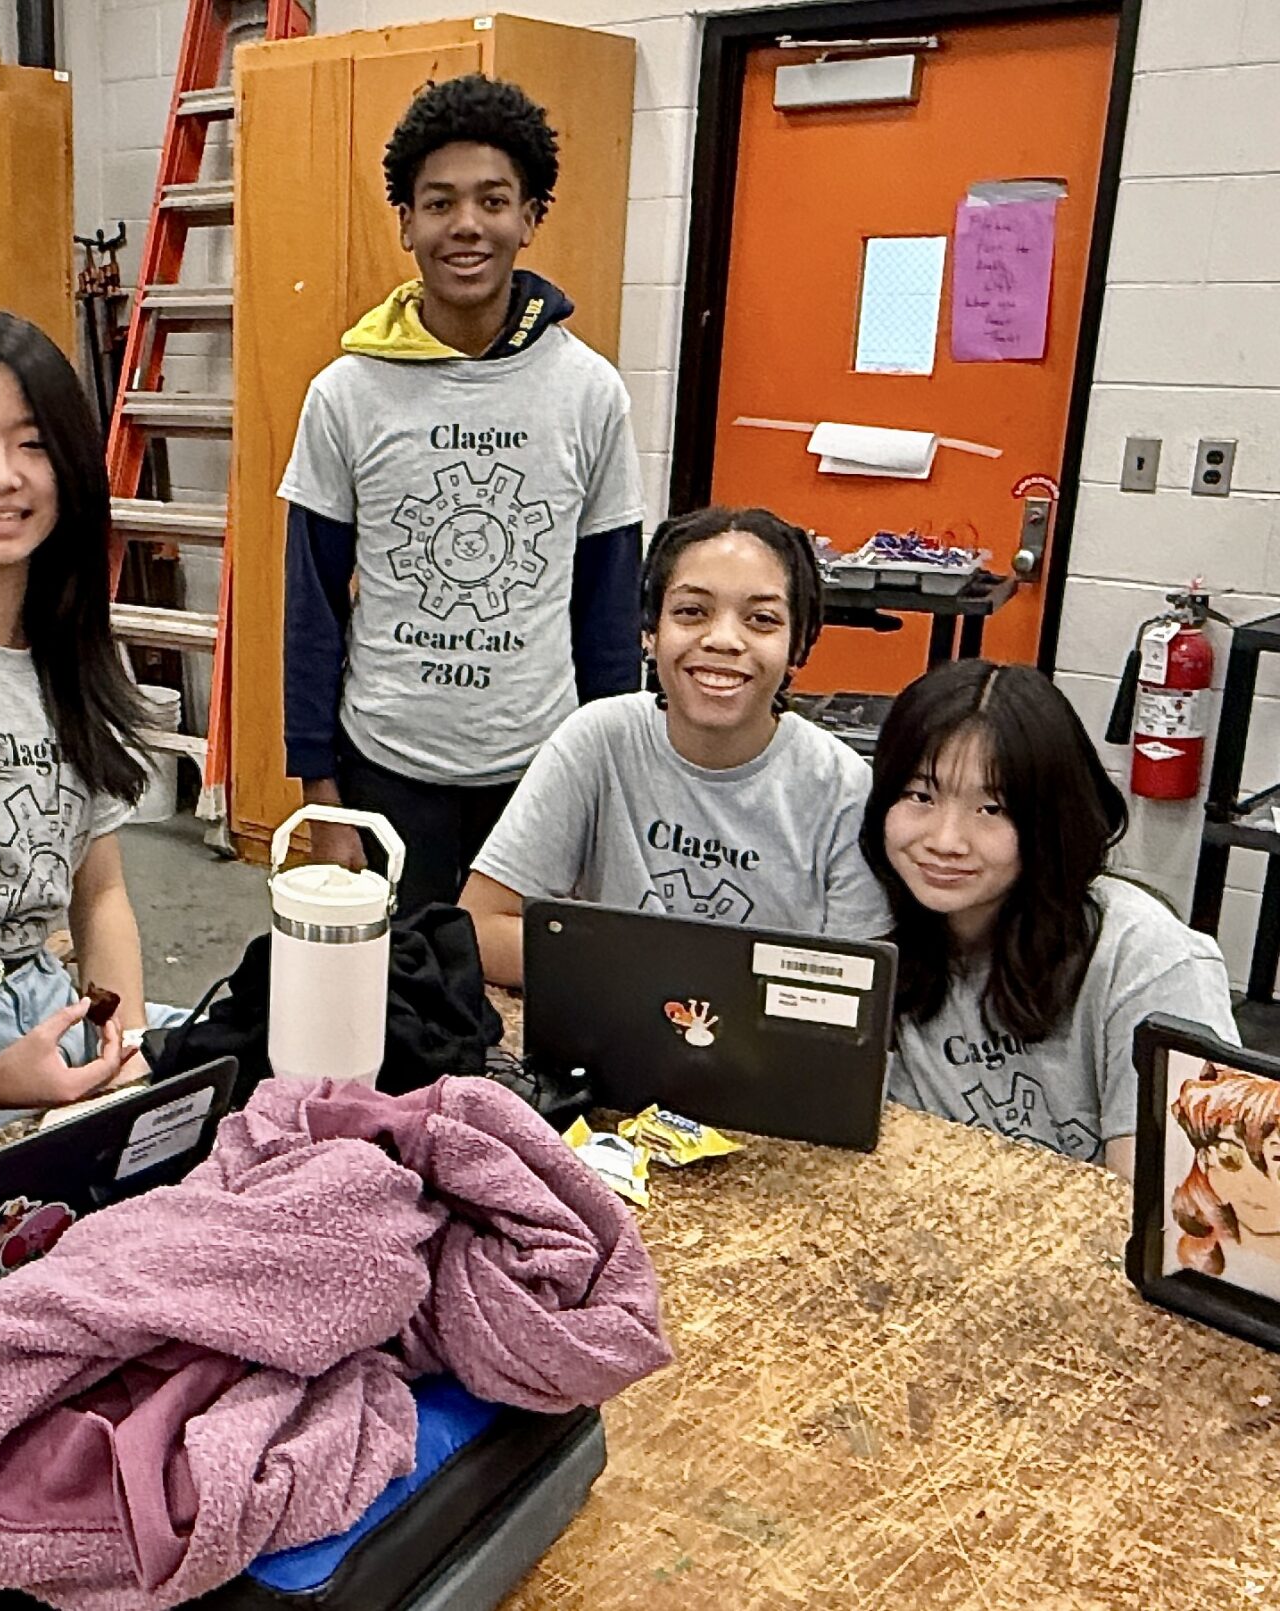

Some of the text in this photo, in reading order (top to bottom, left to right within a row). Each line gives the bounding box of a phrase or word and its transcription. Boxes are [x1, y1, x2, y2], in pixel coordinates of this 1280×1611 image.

[430, 423, 528, 456] Clague
[394, 621, 525, 651] GearCats
[421, 661, 491, 689] 7305
[647, 820, 760, 871] Clague
